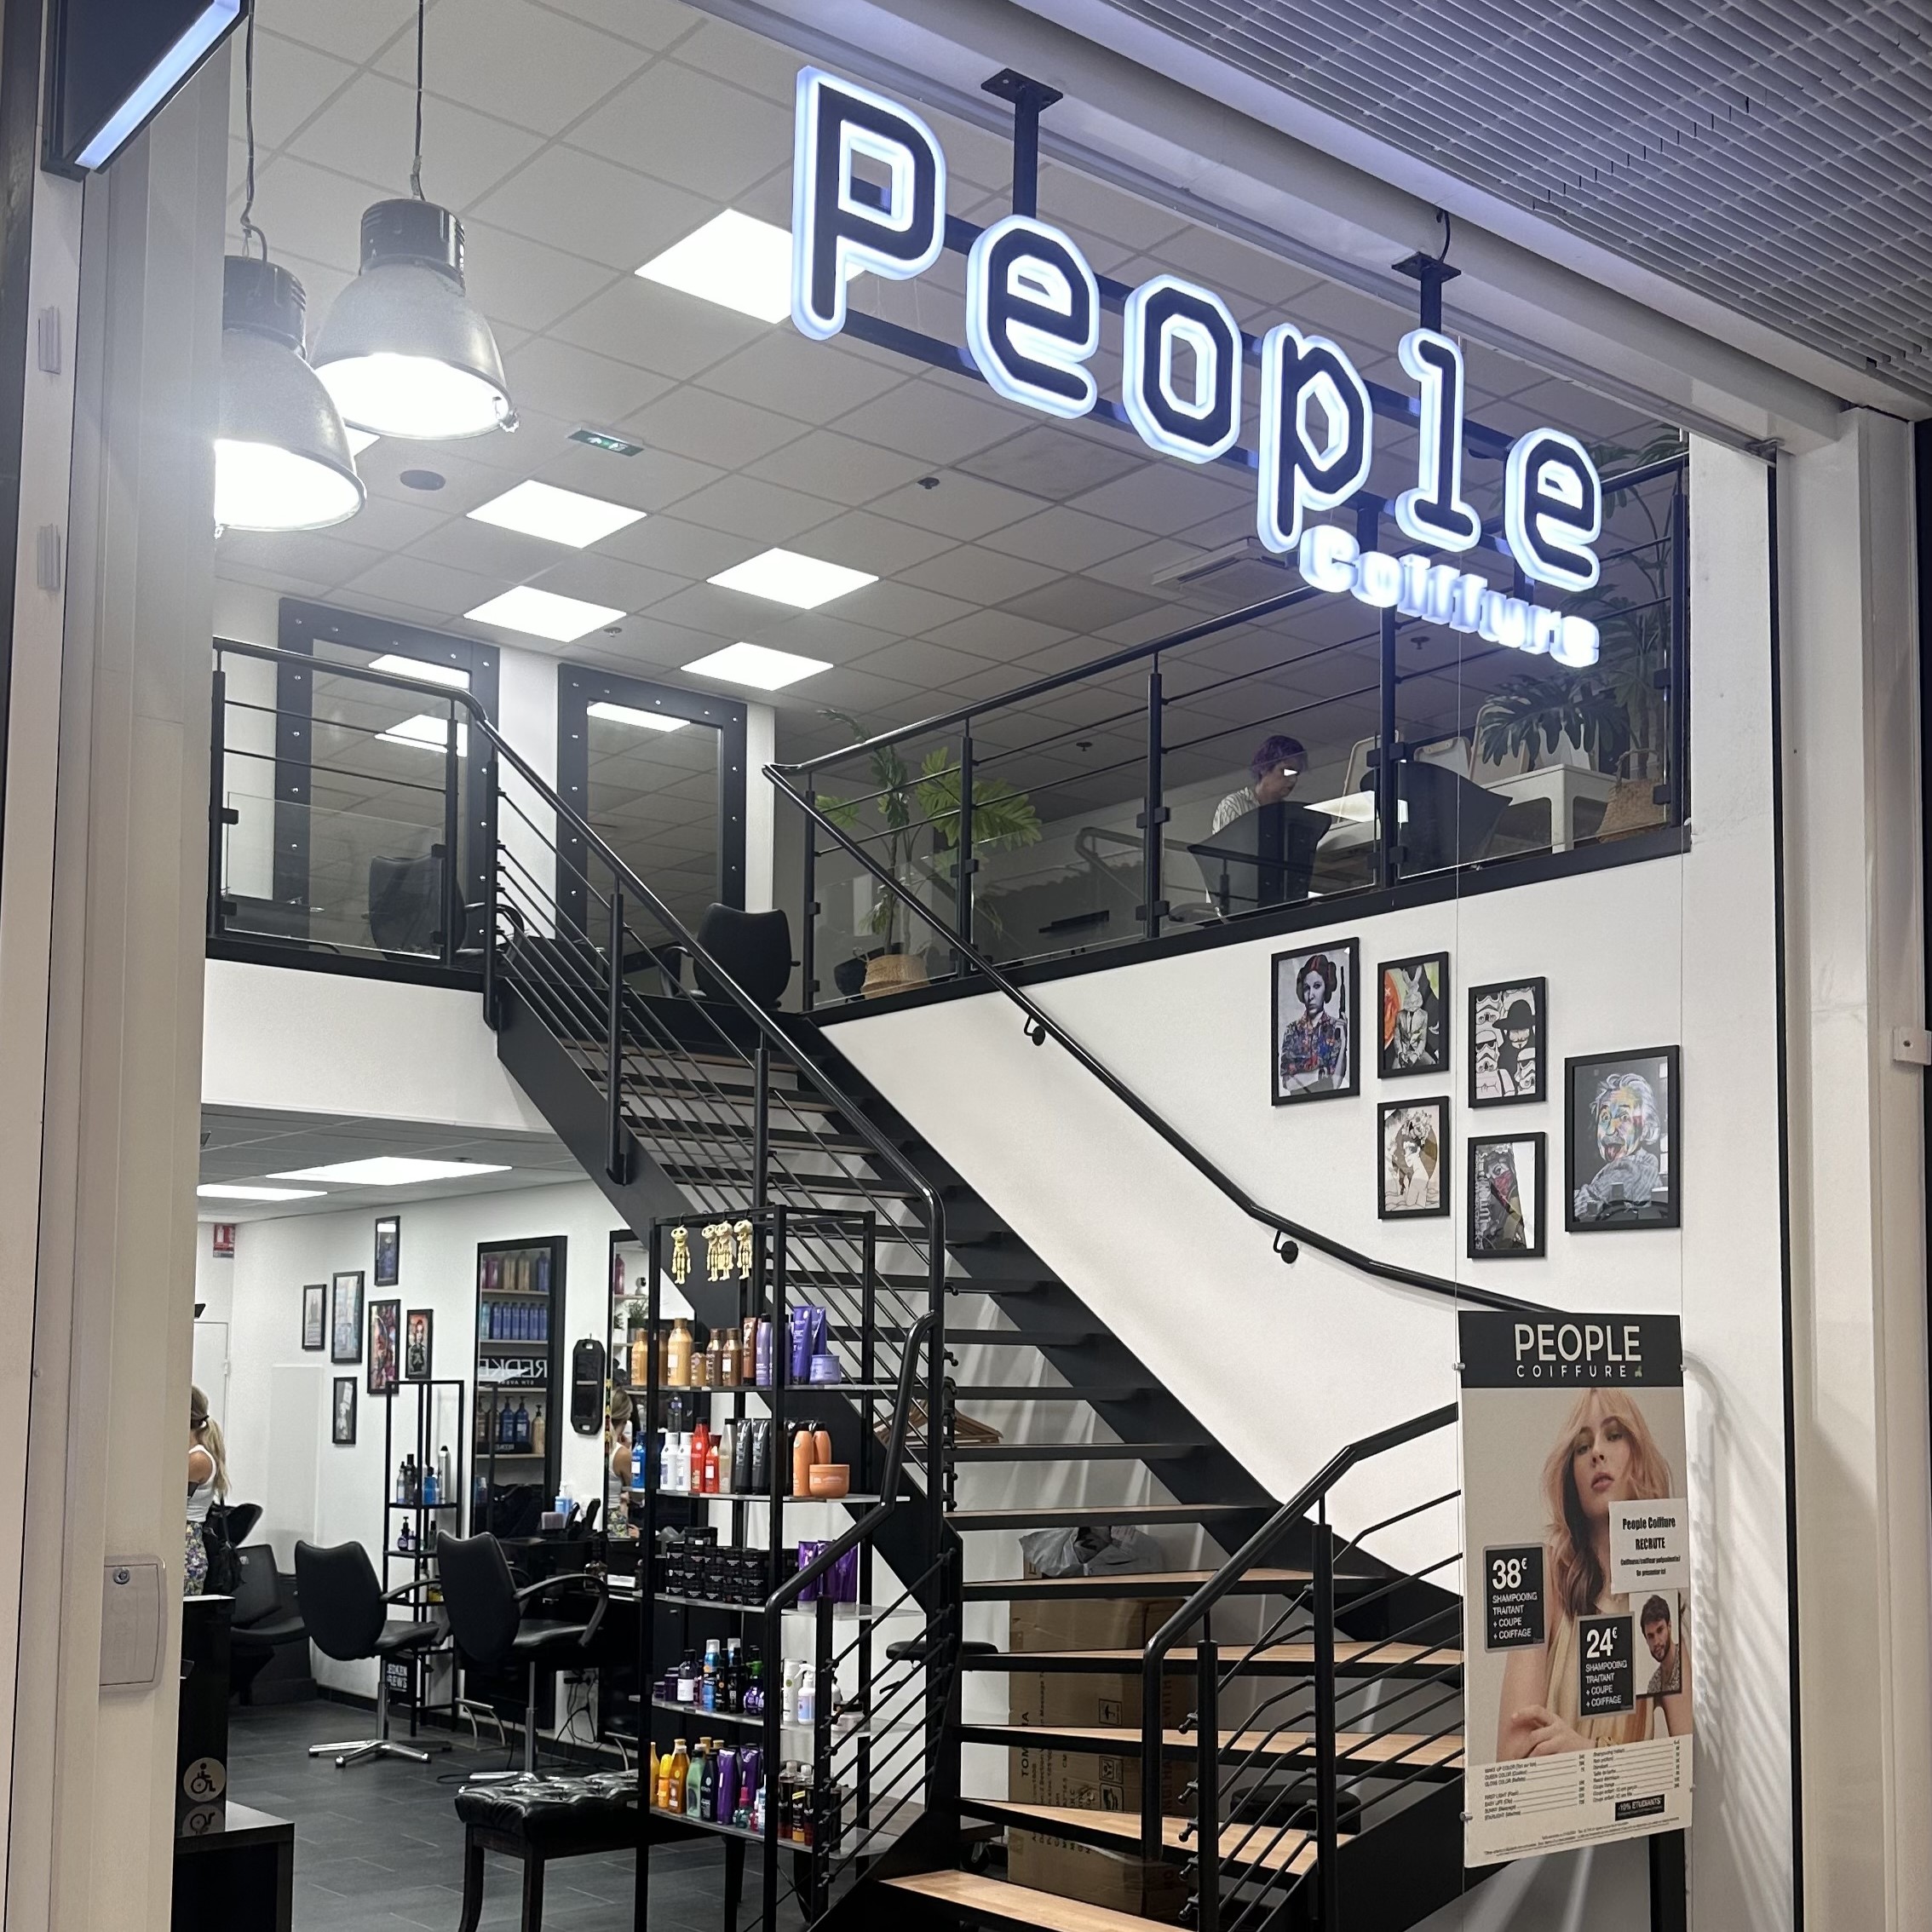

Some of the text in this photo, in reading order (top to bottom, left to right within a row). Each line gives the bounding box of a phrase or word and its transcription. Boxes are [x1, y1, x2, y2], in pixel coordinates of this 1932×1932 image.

[791, 65, 1602, 593] People
[1514, 1323, 1642, 1362] PEOPLE
[1516, 1365, 1627, 1378] COIFFURE
[1622, 1516, 1676, 1531] People Coiffure
[1635, 1537, 1666, 1550] RECRUTE
[1492, 1591, 1538, 1604] SHAMPOOING
[1492, 1605, 1525, 1616] TRAITANT
[1498, 1617, 1522, 1628] COUPE
[1498, 1628, 1532, 1640] COIFFAGE
[1585, 1660, 1628, 1673] SHAMPOOING
[1585, 1672, 1615, 1684] TRAITANT
[1590, 1684, 1613, 1695] COUPE
[1591, 1695, 1622, 1707] COIFFAGE
